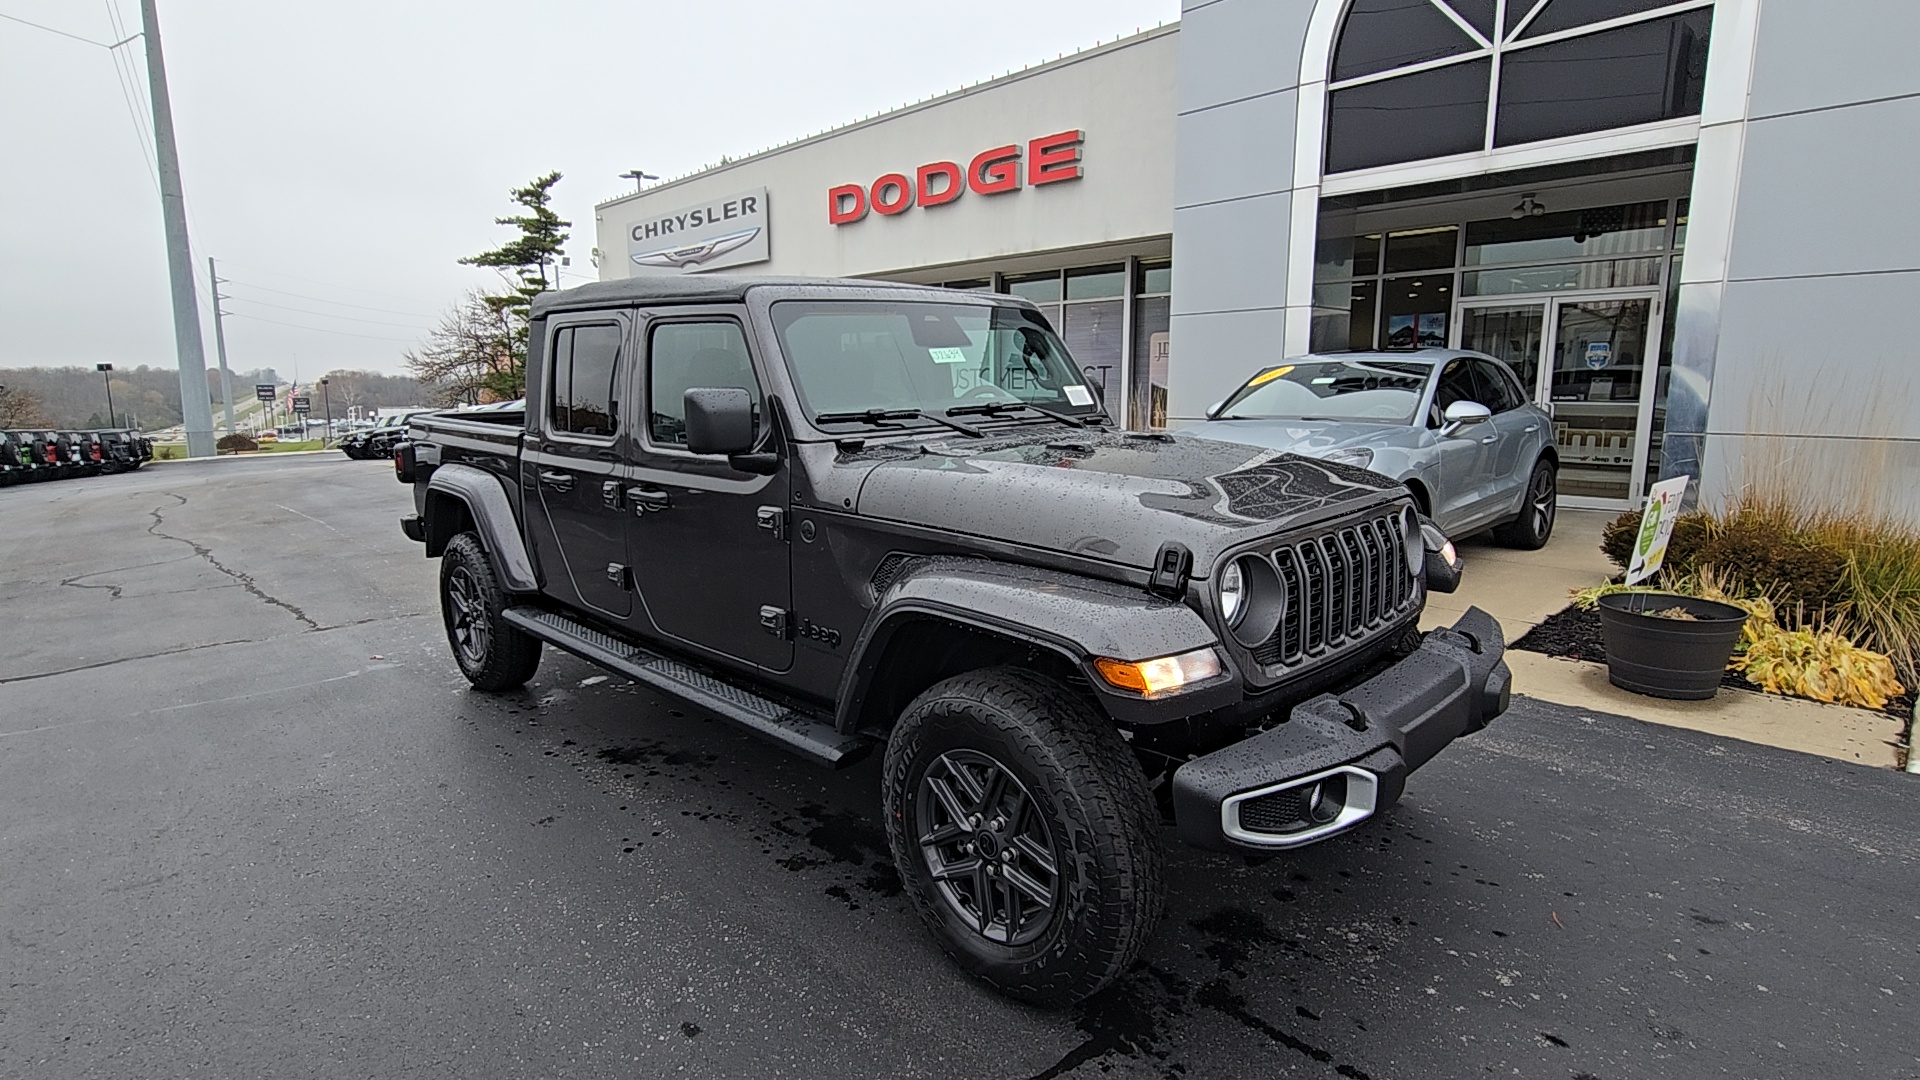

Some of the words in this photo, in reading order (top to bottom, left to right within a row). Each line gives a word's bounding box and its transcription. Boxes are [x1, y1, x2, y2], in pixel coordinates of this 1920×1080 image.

[828, 128, 1086, 225] DODGE
[631, 196, 758, 242] CHRYSLER
[798, 617, 842, 649] Jeep
